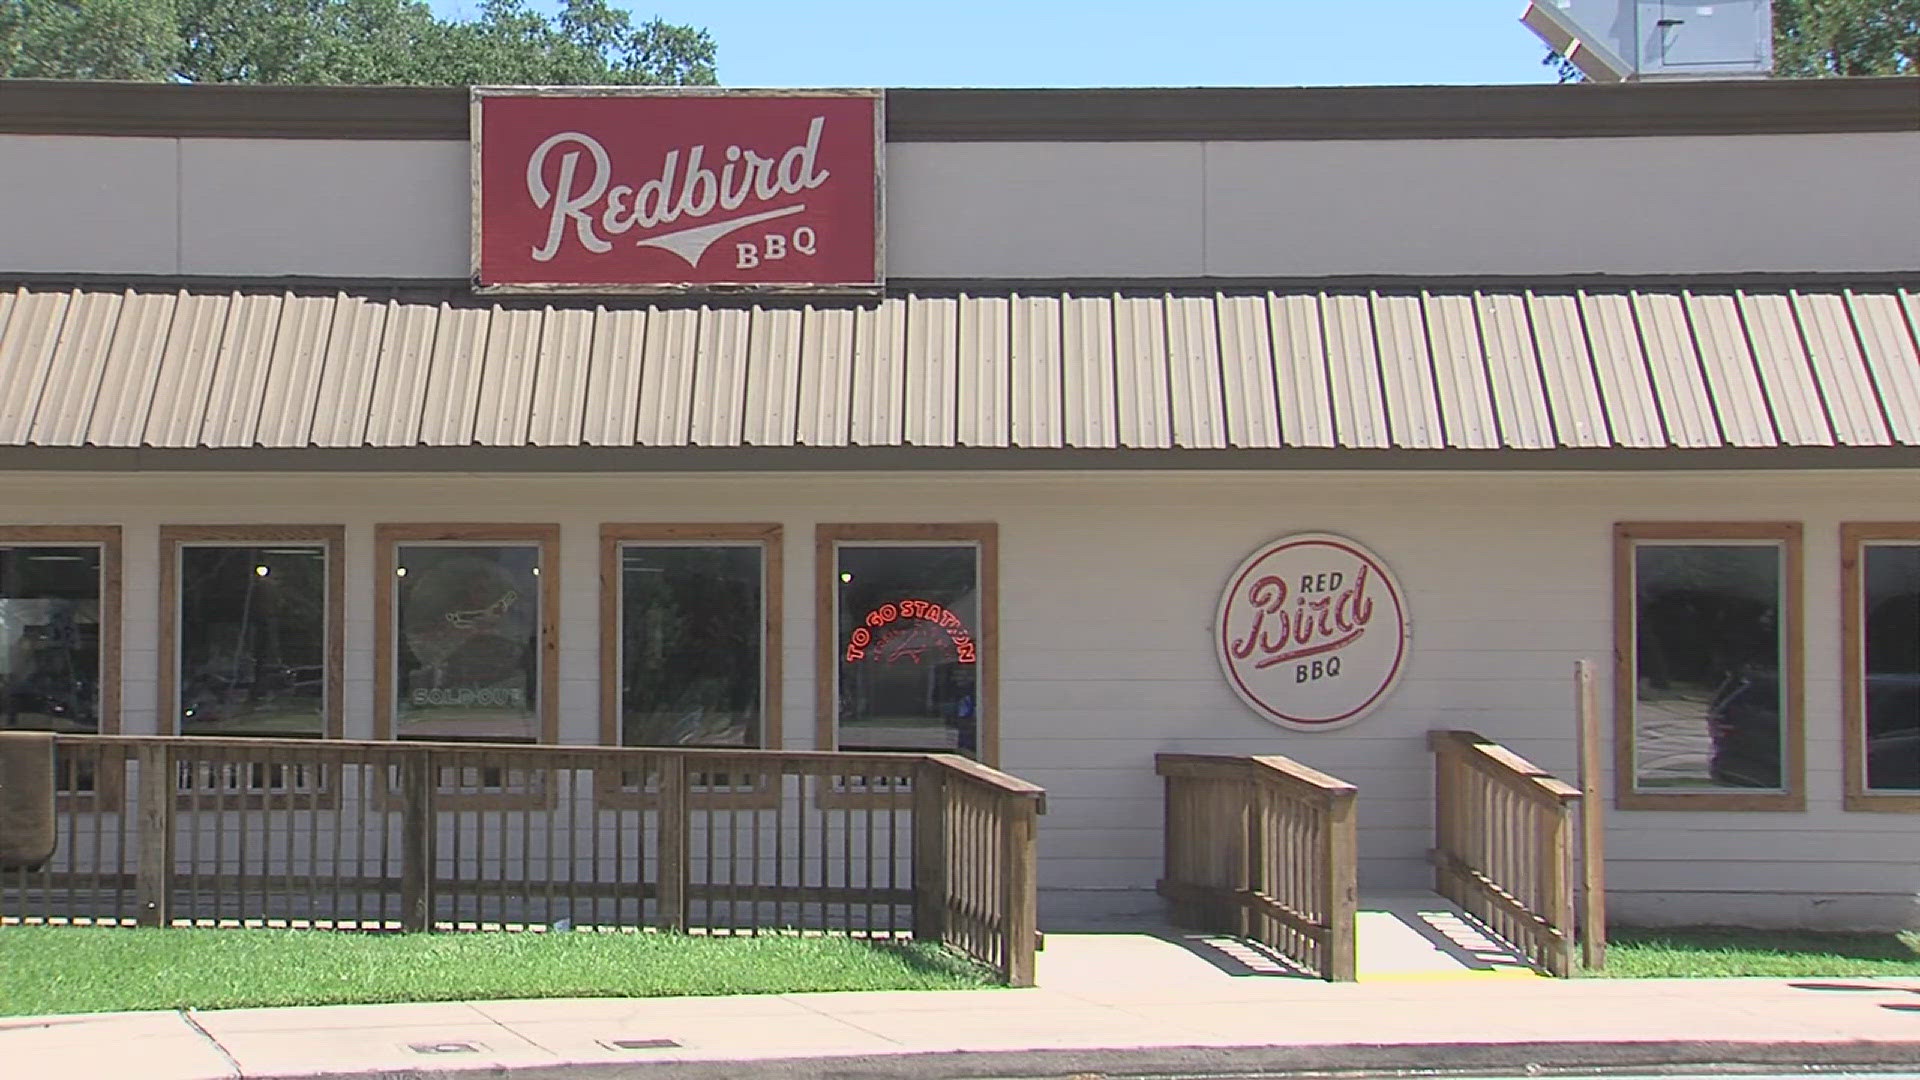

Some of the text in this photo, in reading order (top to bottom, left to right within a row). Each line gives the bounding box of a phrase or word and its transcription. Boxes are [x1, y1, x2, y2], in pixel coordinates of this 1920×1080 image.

[526, 116, 830, 262] Redbird
[736, 226, 816, 269] BBQ
[1300, 571, 1344, 594] RED
[846, 627, 871, 662] TO
[865, 603, 898, 627] GO
[1231, 564, 1373, 660] Bird
[1296, 656, 1342, 684] BBQ
